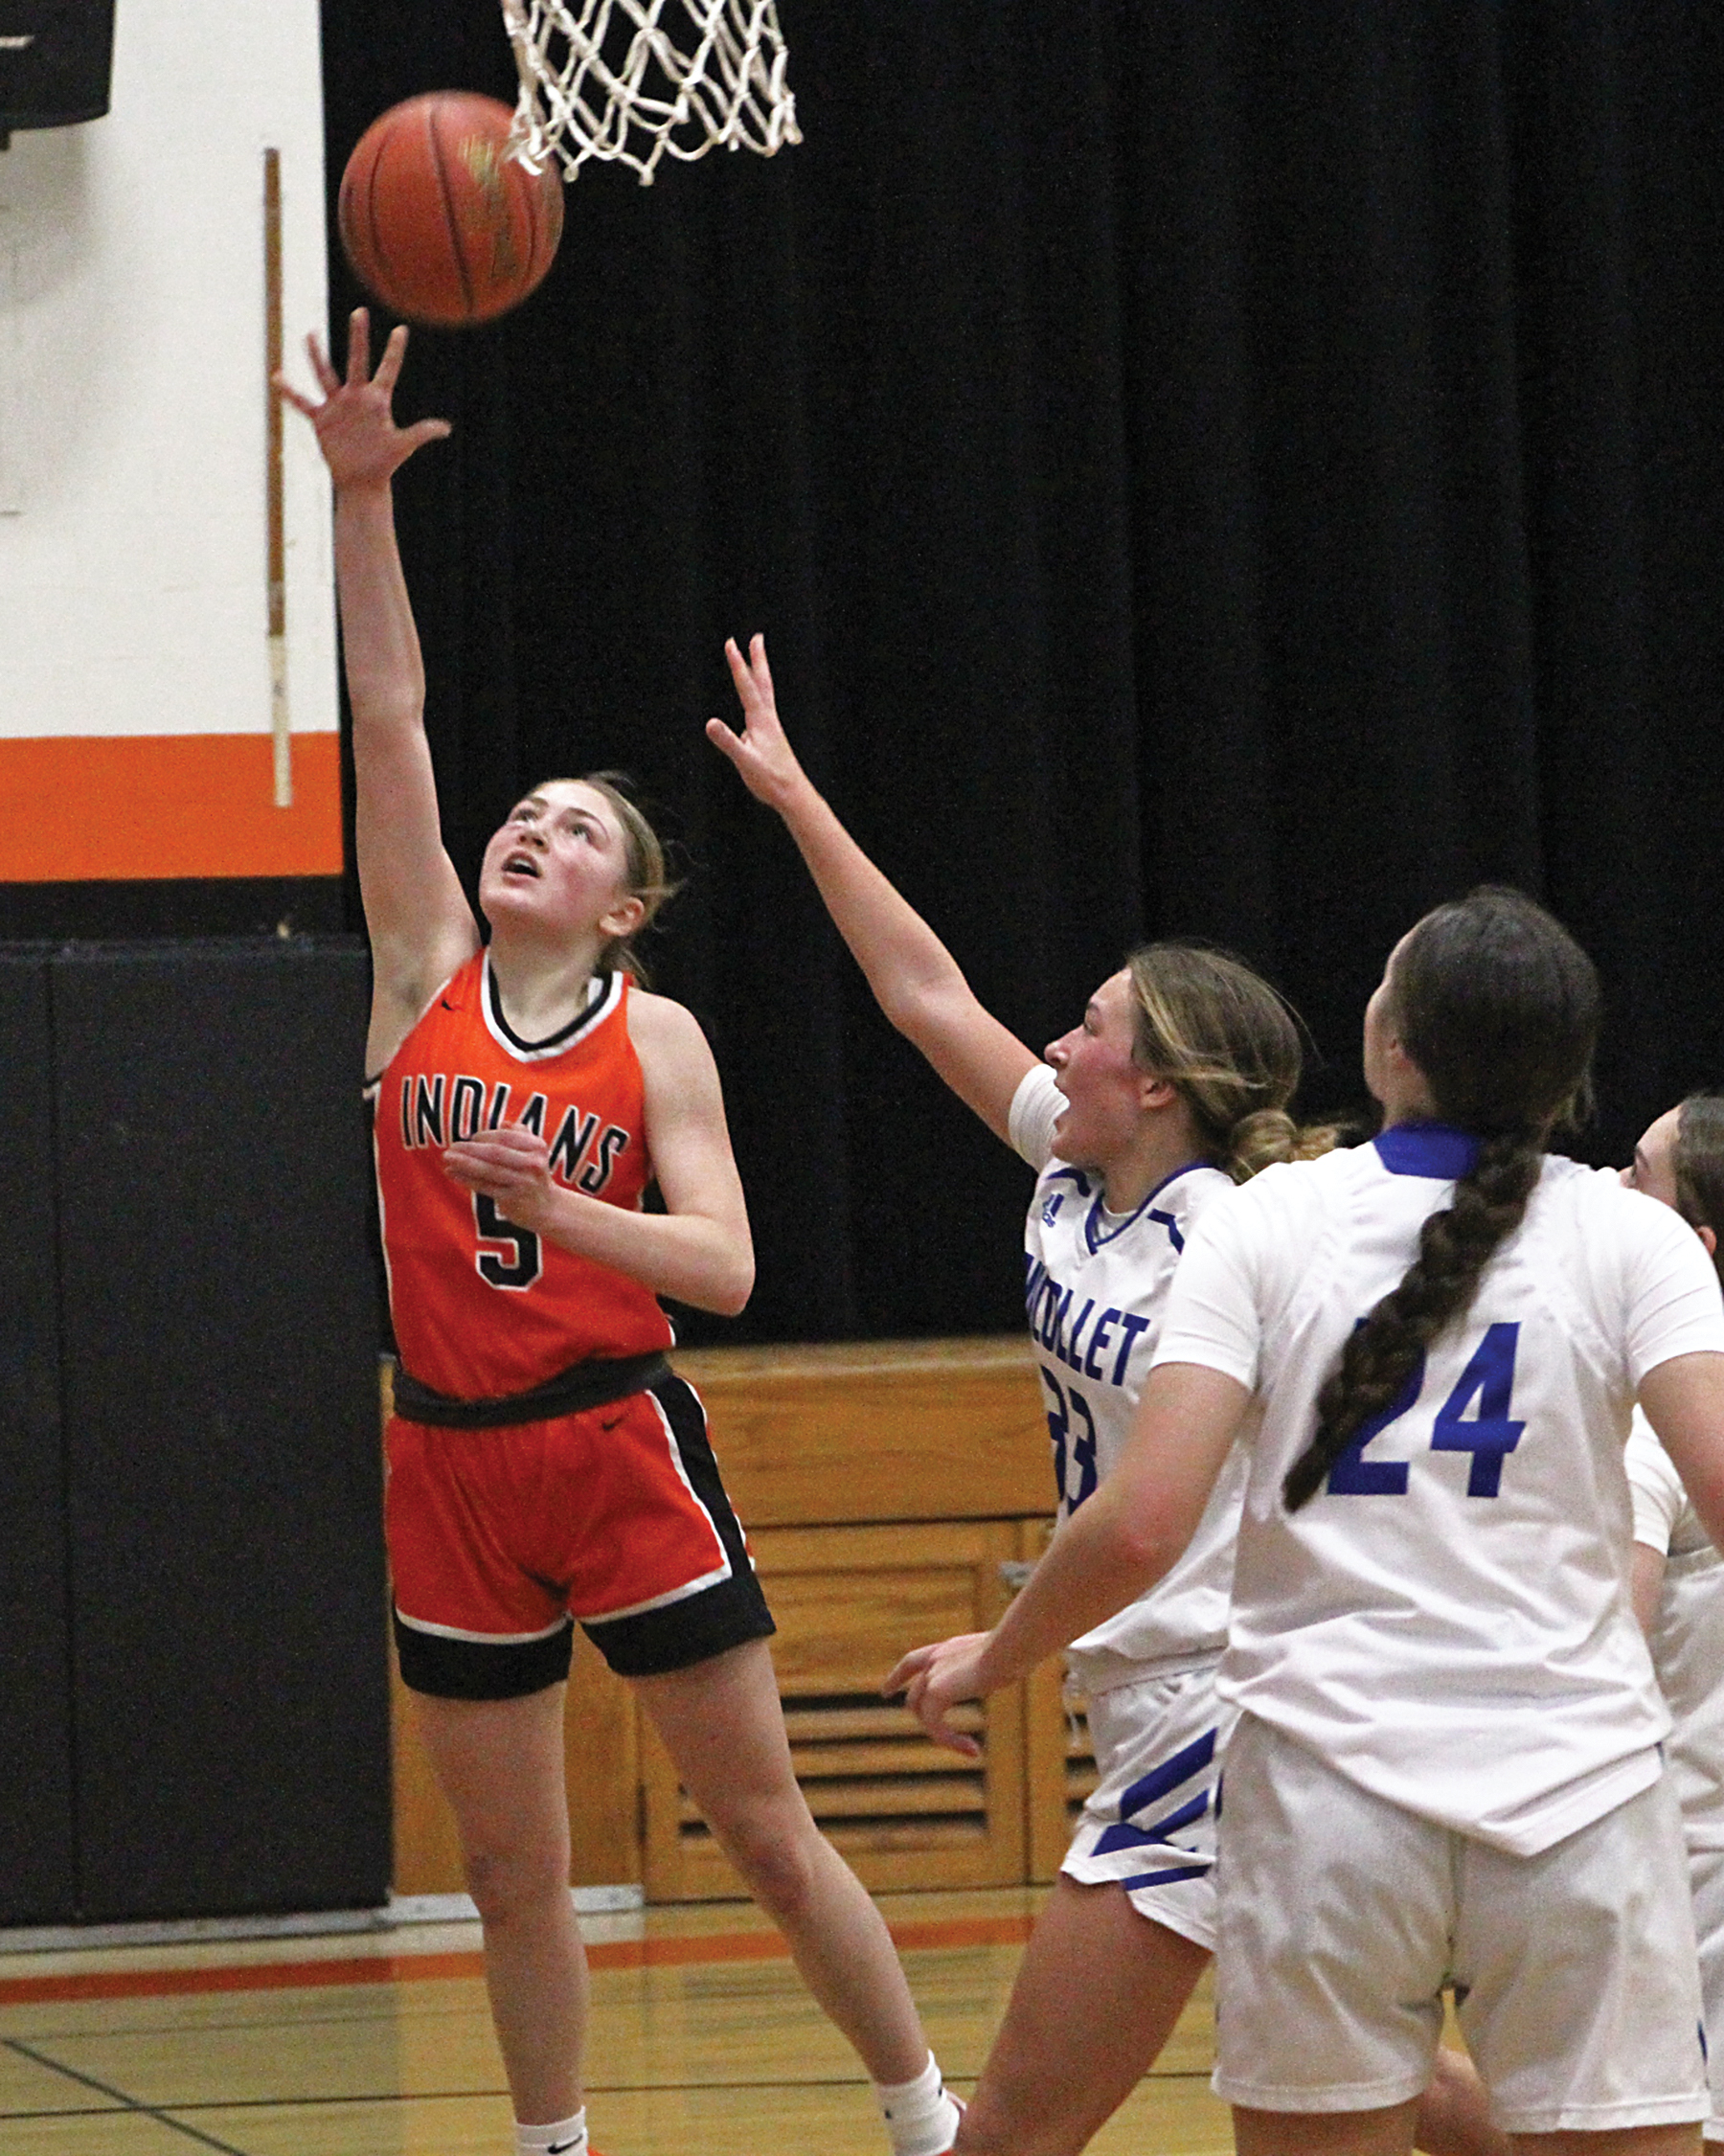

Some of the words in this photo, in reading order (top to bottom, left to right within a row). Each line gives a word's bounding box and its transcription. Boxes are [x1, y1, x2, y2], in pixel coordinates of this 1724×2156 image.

[400, 1074, 631, 1196] INDIANS
[471, 1189, 543, 1292] 5
[1326, 1317, 1527, 1498] 24
